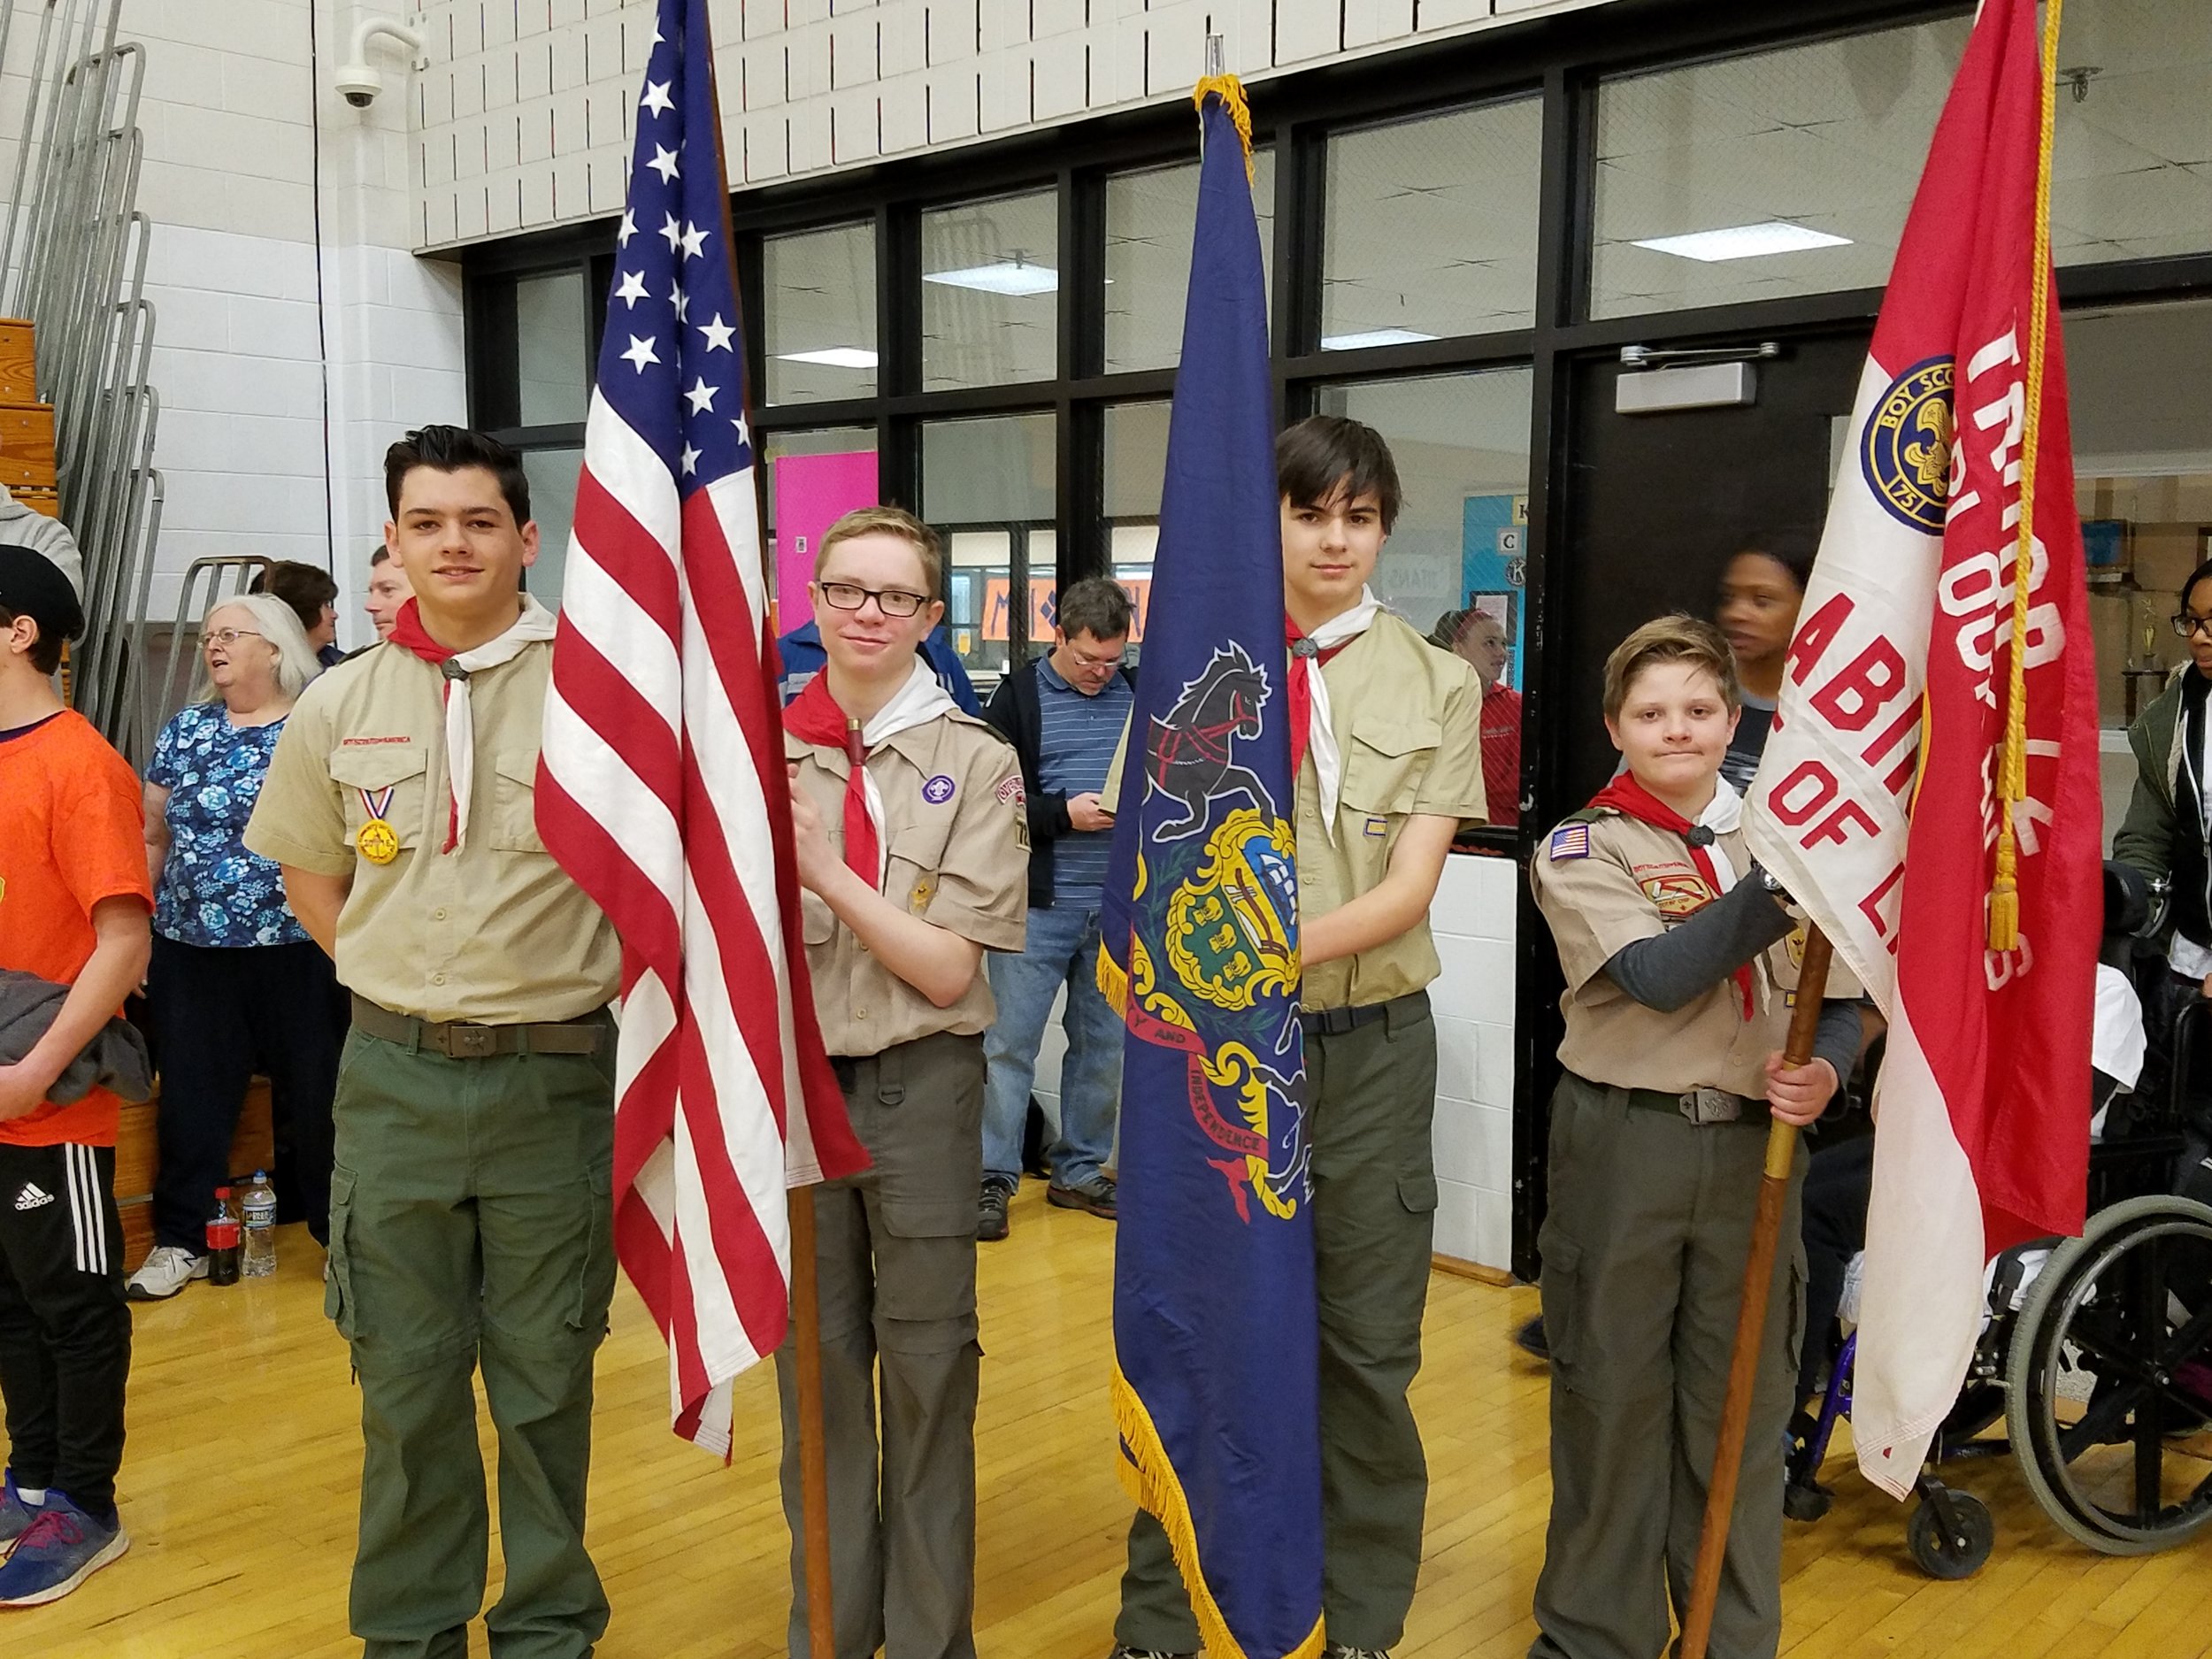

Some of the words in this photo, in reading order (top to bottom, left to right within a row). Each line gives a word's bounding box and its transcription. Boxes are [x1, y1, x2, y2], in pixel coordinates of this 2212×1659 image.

[1879, 387, 1915, 429] BOY
[1892, 484, 1915, 508] 75
[1504, 534, 1515, 549] C
[1768, 760, 1881, 850] OF
[1154, 1028, 1186, 1043] AND
[1190, 1069, 1261, 1150] INDEPENDENCE
[14, 1194, 55, 1211] adidas
